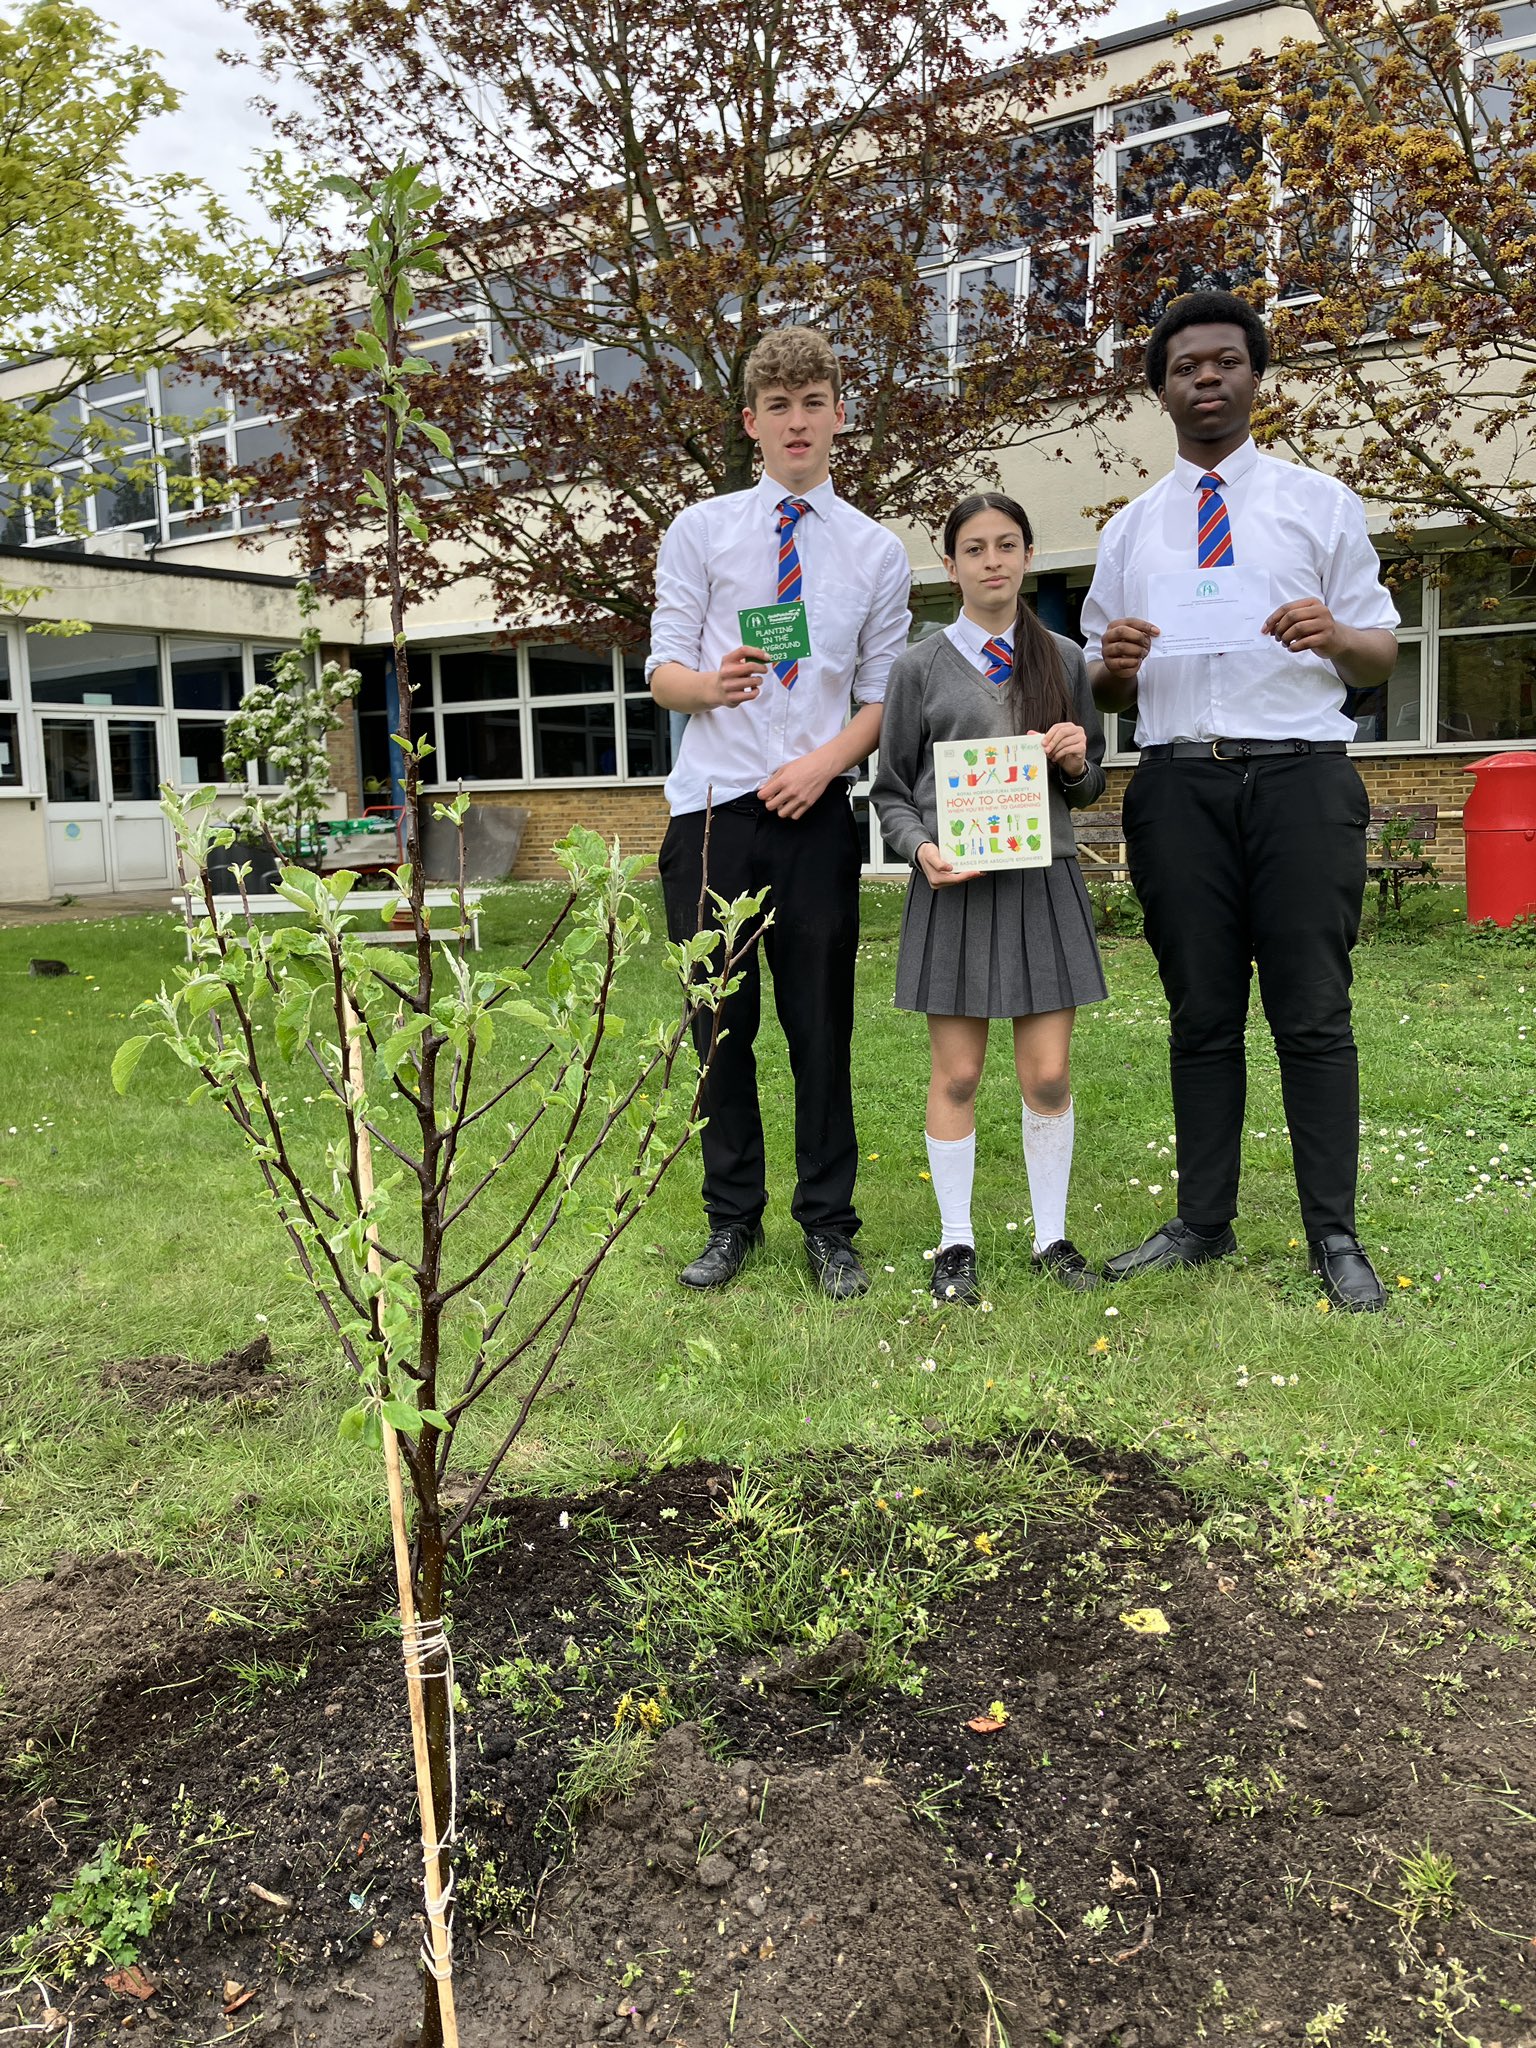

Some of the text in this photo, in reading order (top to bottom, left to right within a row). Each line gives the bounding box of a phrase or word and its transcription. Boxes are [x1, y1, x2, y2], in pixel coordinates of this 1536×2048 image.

[756, 626, 793, 637] PLANTING
[762, 634, 789, 645] IN THE
[770, 652, 788, 661] 2023
[946, 792, 1041, 808] HOW TO GARDEN
